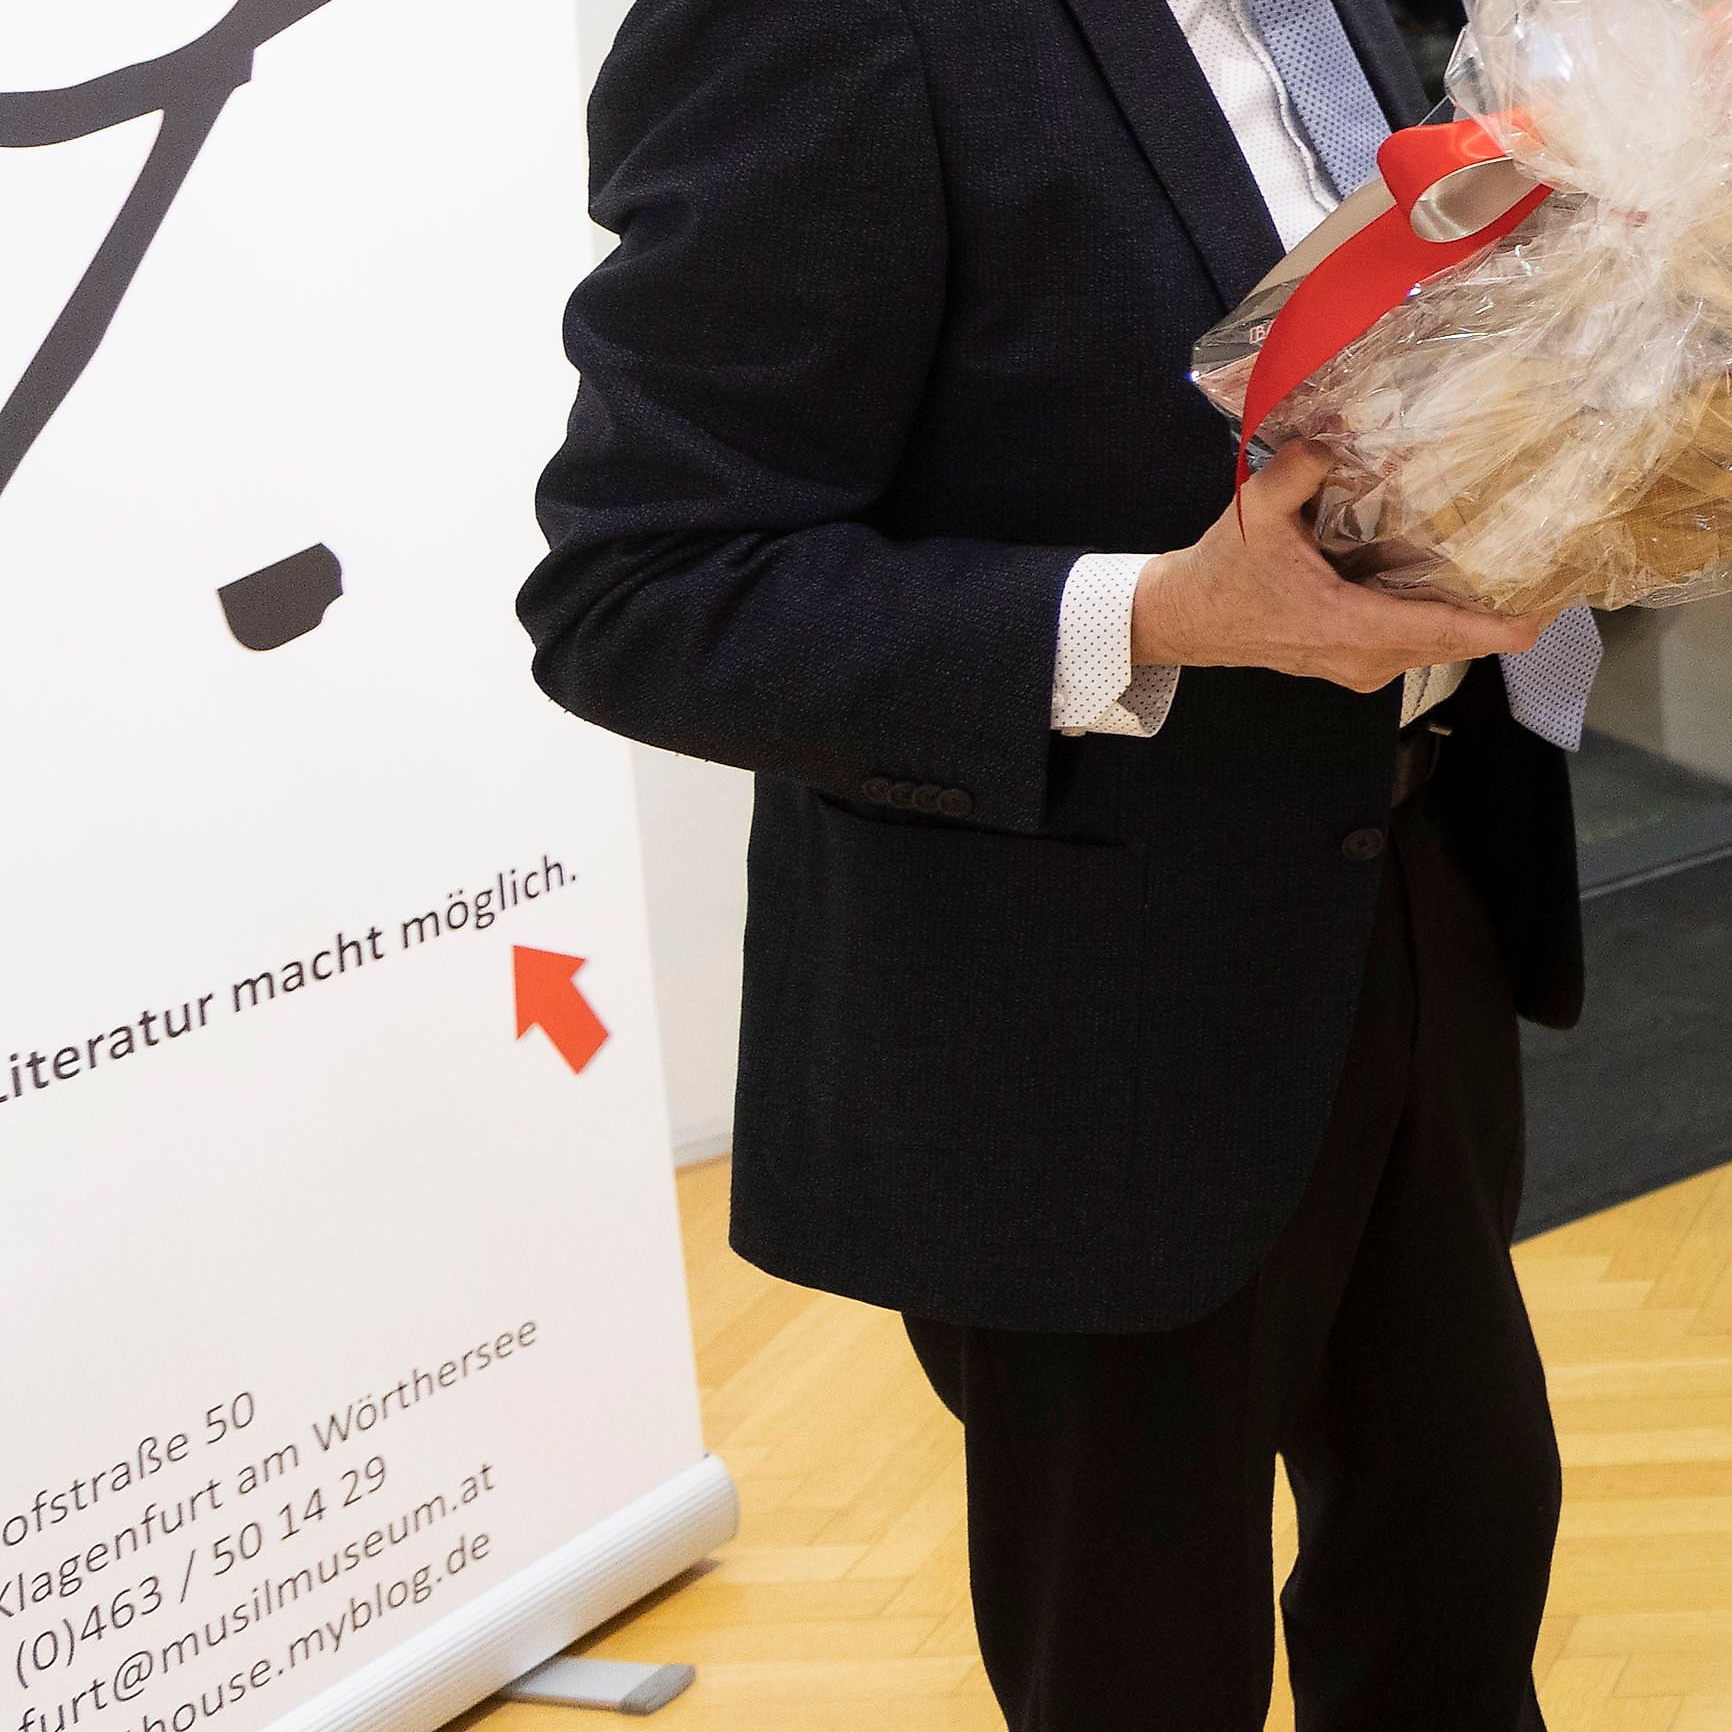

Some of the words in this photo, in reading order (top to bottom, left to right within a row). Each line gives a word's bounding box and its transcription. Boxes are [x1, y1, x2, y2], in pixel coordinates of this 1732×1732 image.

[231, 925, 385, 1014] macht
[400, 854, 578, 950] möglich.
[2, 1433, 190, 1548] ofstraße
[205, 1390, 255, 1446] 50
[237, 1442, 299, 1496] am
[312, 1319, 538, 1453] Wörthersee
[16, 1574, 164, 1691] (0)463
[180, 1548, 197, 1604] /
[212, 1521, 263, 1577] 50
[278, 1487, 328, 1541] 14
[340, 1455, 387, 1509] 29
